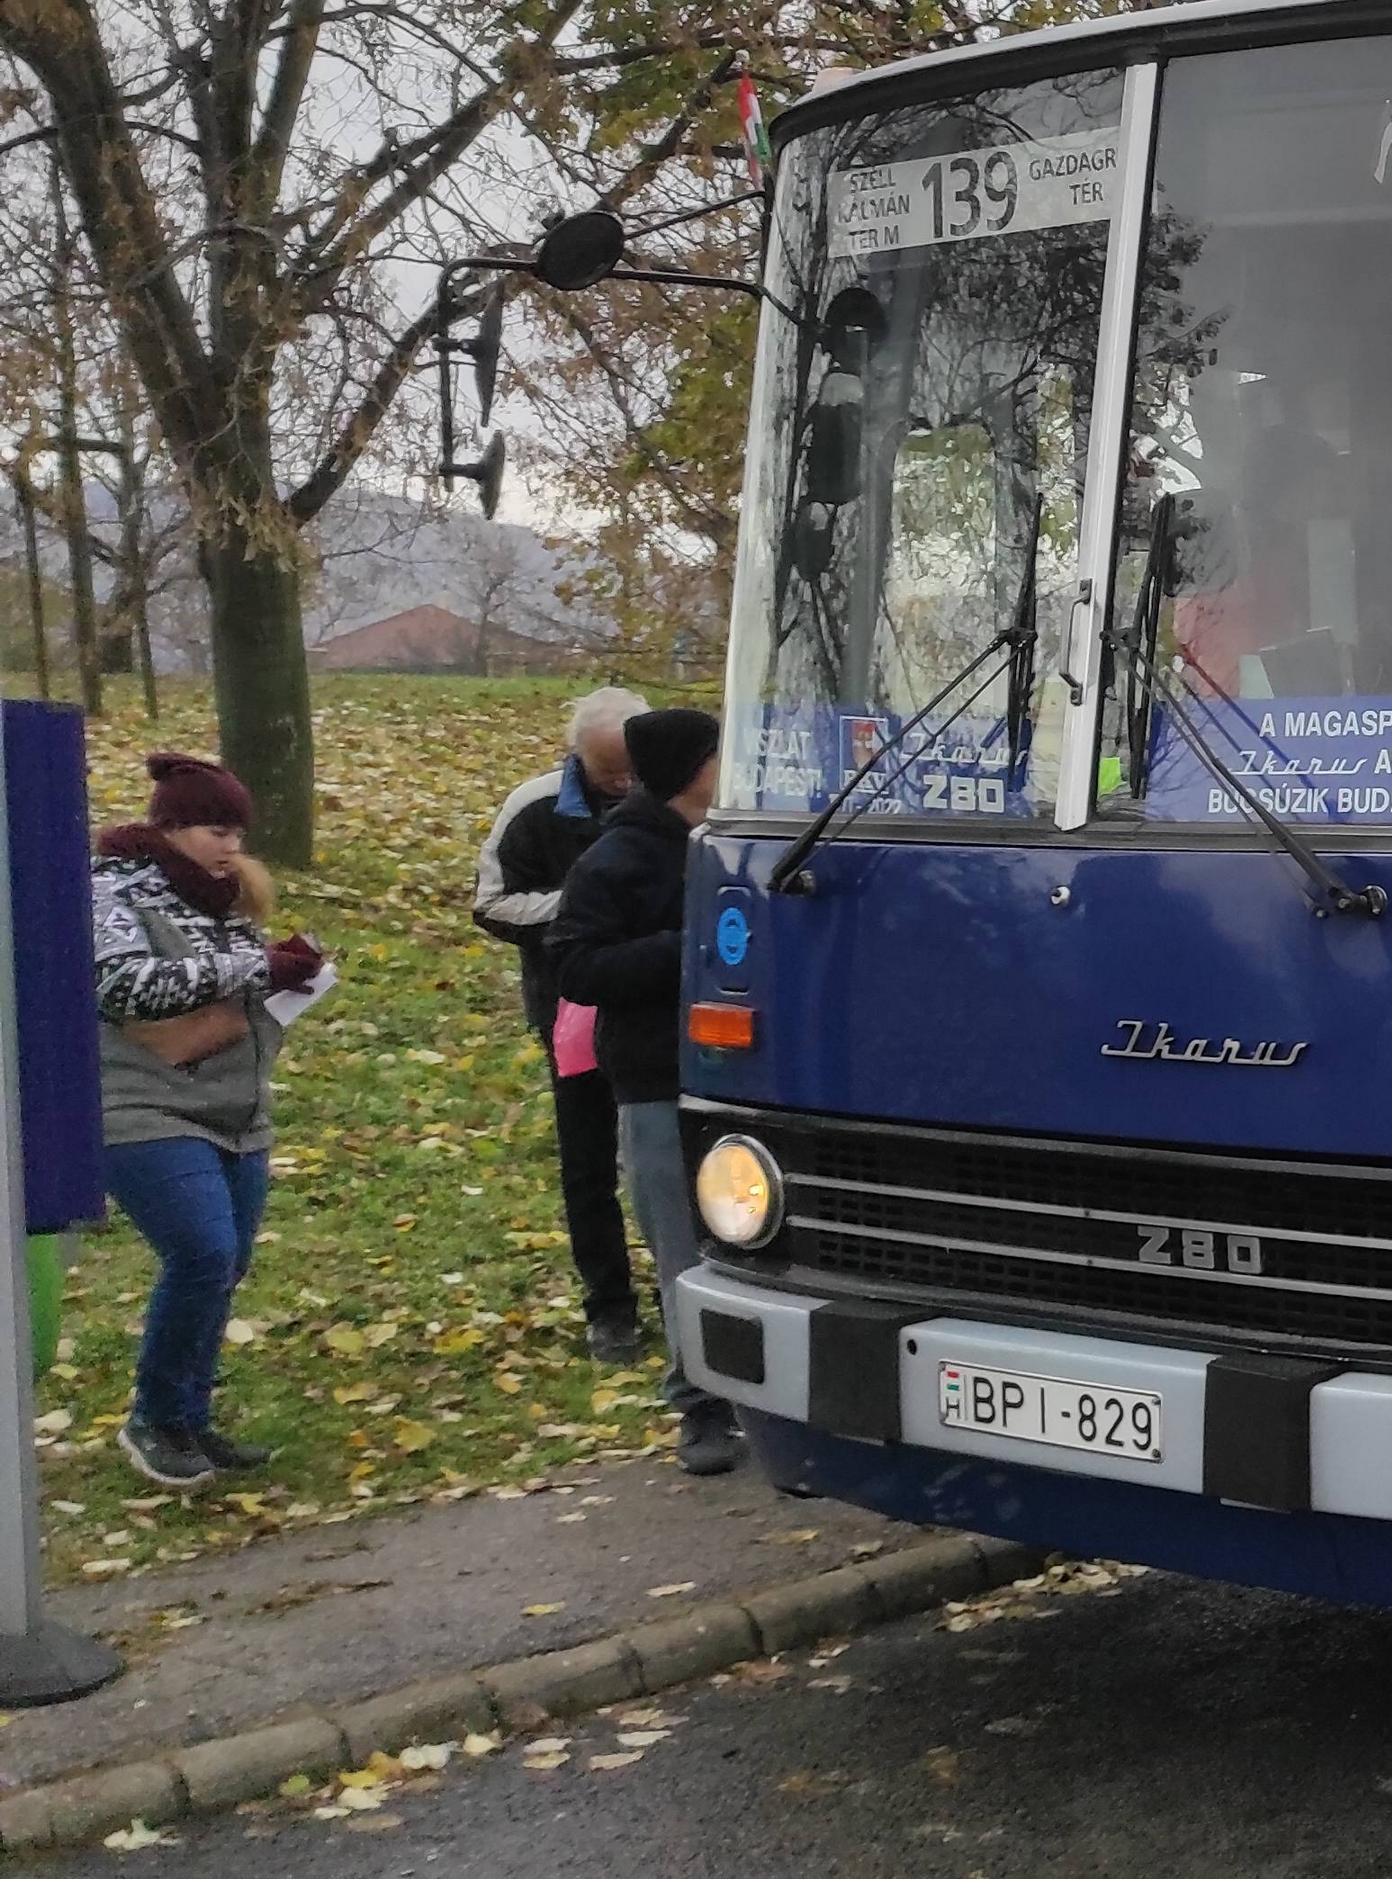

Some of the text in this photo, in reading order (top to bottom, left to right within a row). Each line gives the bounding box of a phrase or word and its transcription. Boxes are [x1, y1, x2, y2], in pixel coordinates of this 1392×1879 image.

[1029, 147, 1117, 181] GAZDAGR
[921, 151, 1018, 238] 139
[1069, 177, 1104, 205] TÉR
[884, 225, 900, 245] M
[1259, 713, 1276, 737] A
[1228, 750, 1369, 775] Ikarus
[1208, 782, 1329, 813] BUCSÚZIK
[1101, 1020, 1309, 1066] Ikarus
[946, 1376, 1152, 1451] H BPI-829
